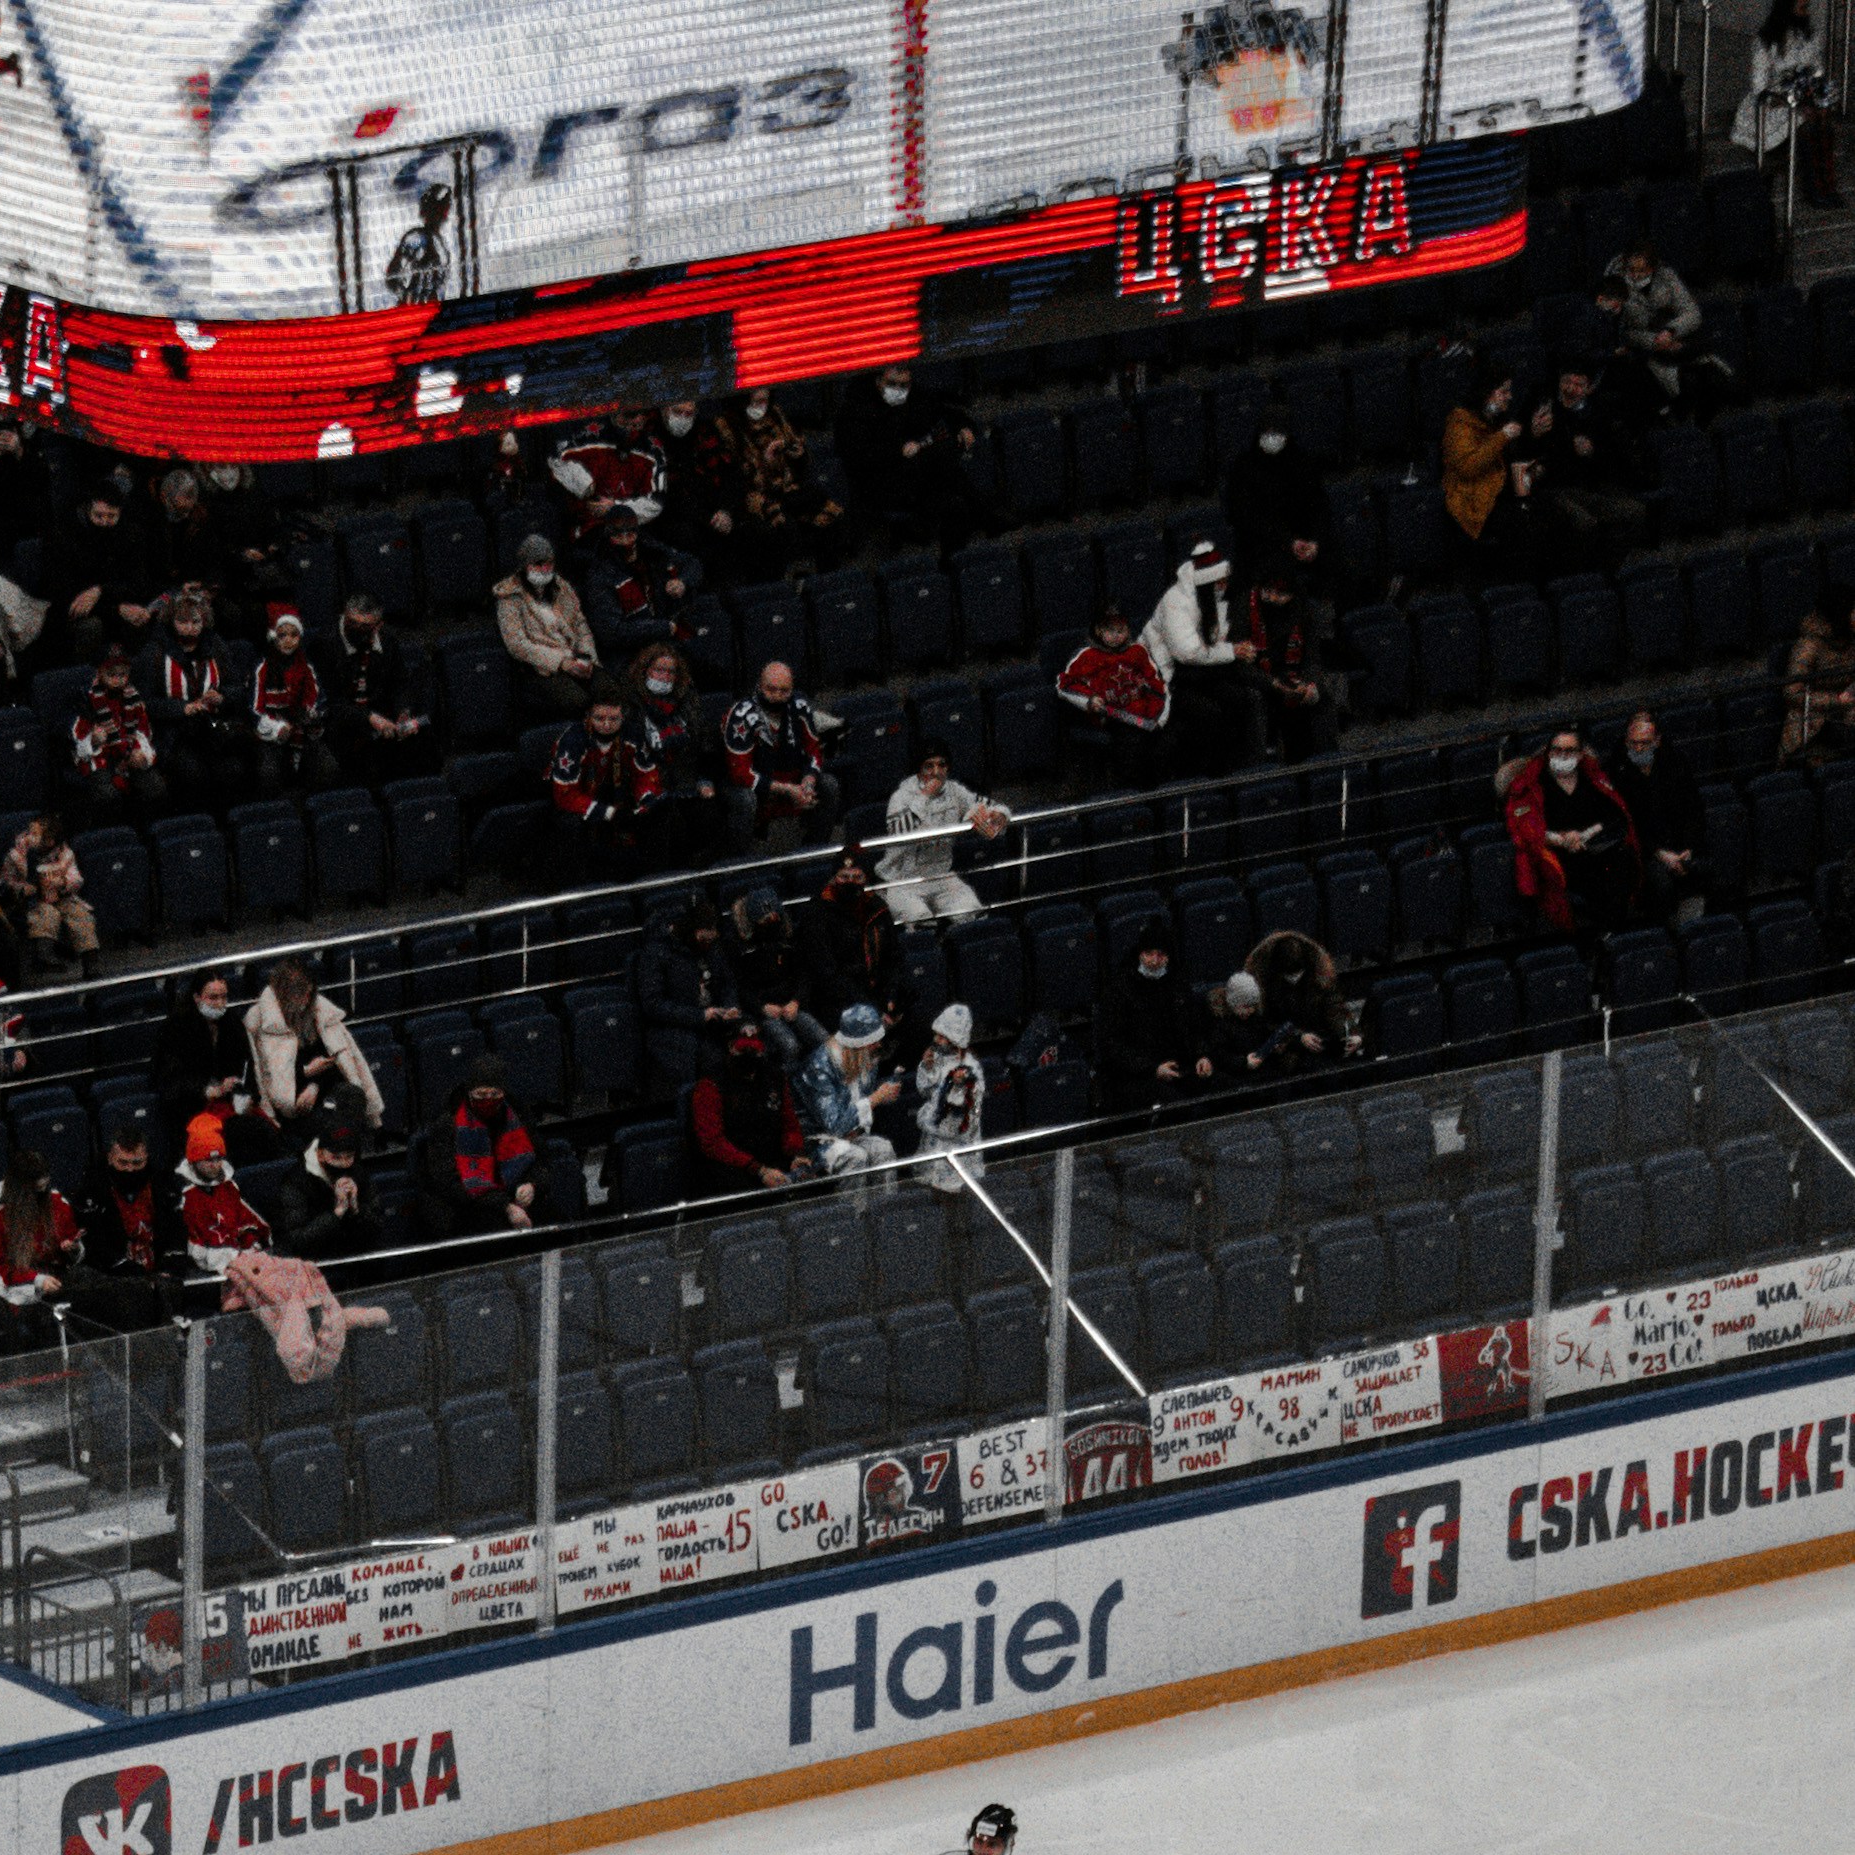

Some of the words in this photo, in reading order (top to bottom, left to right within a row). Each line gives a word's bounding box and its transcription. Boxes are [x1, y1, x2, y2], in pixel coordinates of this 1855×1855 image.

[1115, 162, 1413, 304] ЦСКА
[1713, 1272, 1759, 1294] ТОЛЬКО
[1687, 1291, 1711, 1311] 23
[1712, 1314, 1756, 1338] ТОЛЬКО
[1748, 1323, 1802, 1351] ПОБЕДА
[1553, 1330, 1617, 1382] SKA
[1643, 1353, 1667, 1375] 23
[1260, 1366, 1321, 1392] МАМИН
[1355, 1365, 1421, 1394] ЗАЩИЩАЕТ
[1173, 1409, 1216, 1431] АНТОН
[1230, 1396, 1244, 1422] 9
[1279, 1396, 1300, 1421] 98
[1344, 1396, 1382, 1420] ЦСКА
[1372, 1401, 1440, 1431] ПРОПУСКАЕТ
[979, 1429, 1027, 1460] BEST
[921, 1449, 950, 1495] 7
[970, 1464, 984, 1490] 6
[1082, 1452, 1129, 1501] 44
[656, 1492, 736, 1521] КАРНАУХОВ
[961, 1485, 1047, 1517] DEFENSEME
[593, 1518, 617, 1536] МЫ
[725, 1508, 751, 1554] 15
[817, 1515, 852, 1551] GO!
[597, 1541, 610, 1554] НЕ
[624, 1533, 645, 1547] РАЗ
[469, 1557, 526, 1579] СЕРДЦАХ
[607, 1556, 641, 1573] КУБОК
[584, 1580, 631, 1602] РУКАМИ
[248, 1601, 347, 1637] ДИНСТВЕННОЙ
[379, 1603, 413, 1622] НАМ
[479, 1601, 524, 1622] ЦВЕТА
[250, 1634, 321, 1669] ОМАНДЕ
[348, 1633, 363, 1650] НЕ
[788, 1579, 1126, 1748] Haier
